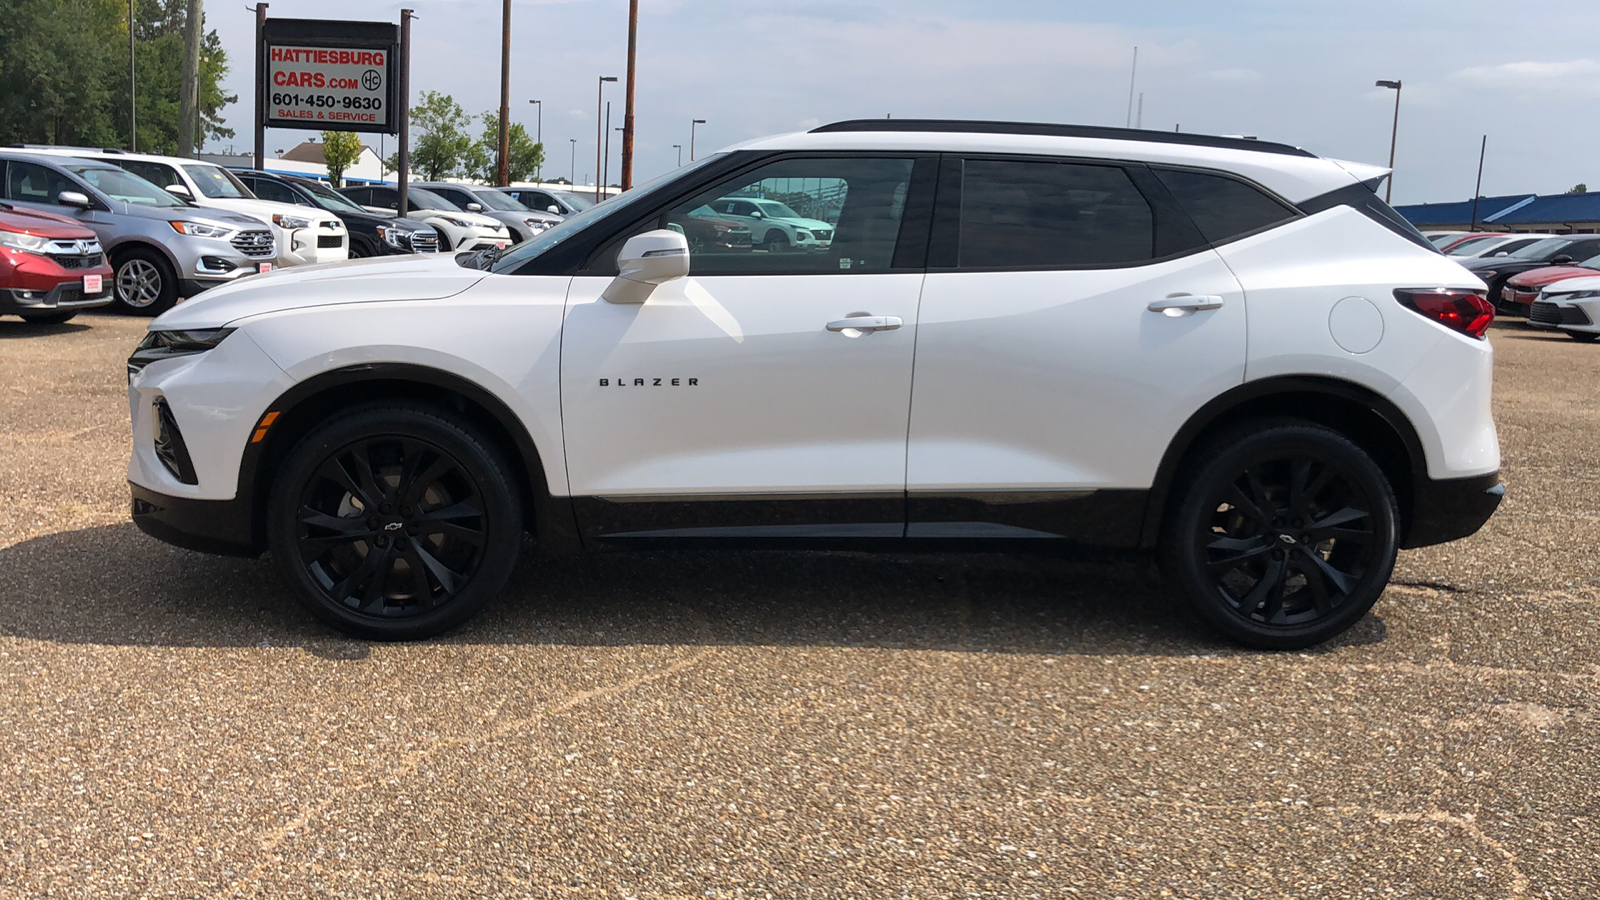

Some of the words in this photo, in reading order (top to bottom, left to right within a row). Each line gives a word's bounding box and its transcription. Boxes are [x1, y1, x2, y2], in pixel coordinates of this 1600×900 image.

[272, 48, 384, 66] HATTIESBURG
[272, 93, 382, 110] 601-450-9630
[278, 109, 314, 119] SALES
[328, 112, 376, 122] SERVICE
[599, 378, 699, 387] BLAZER
